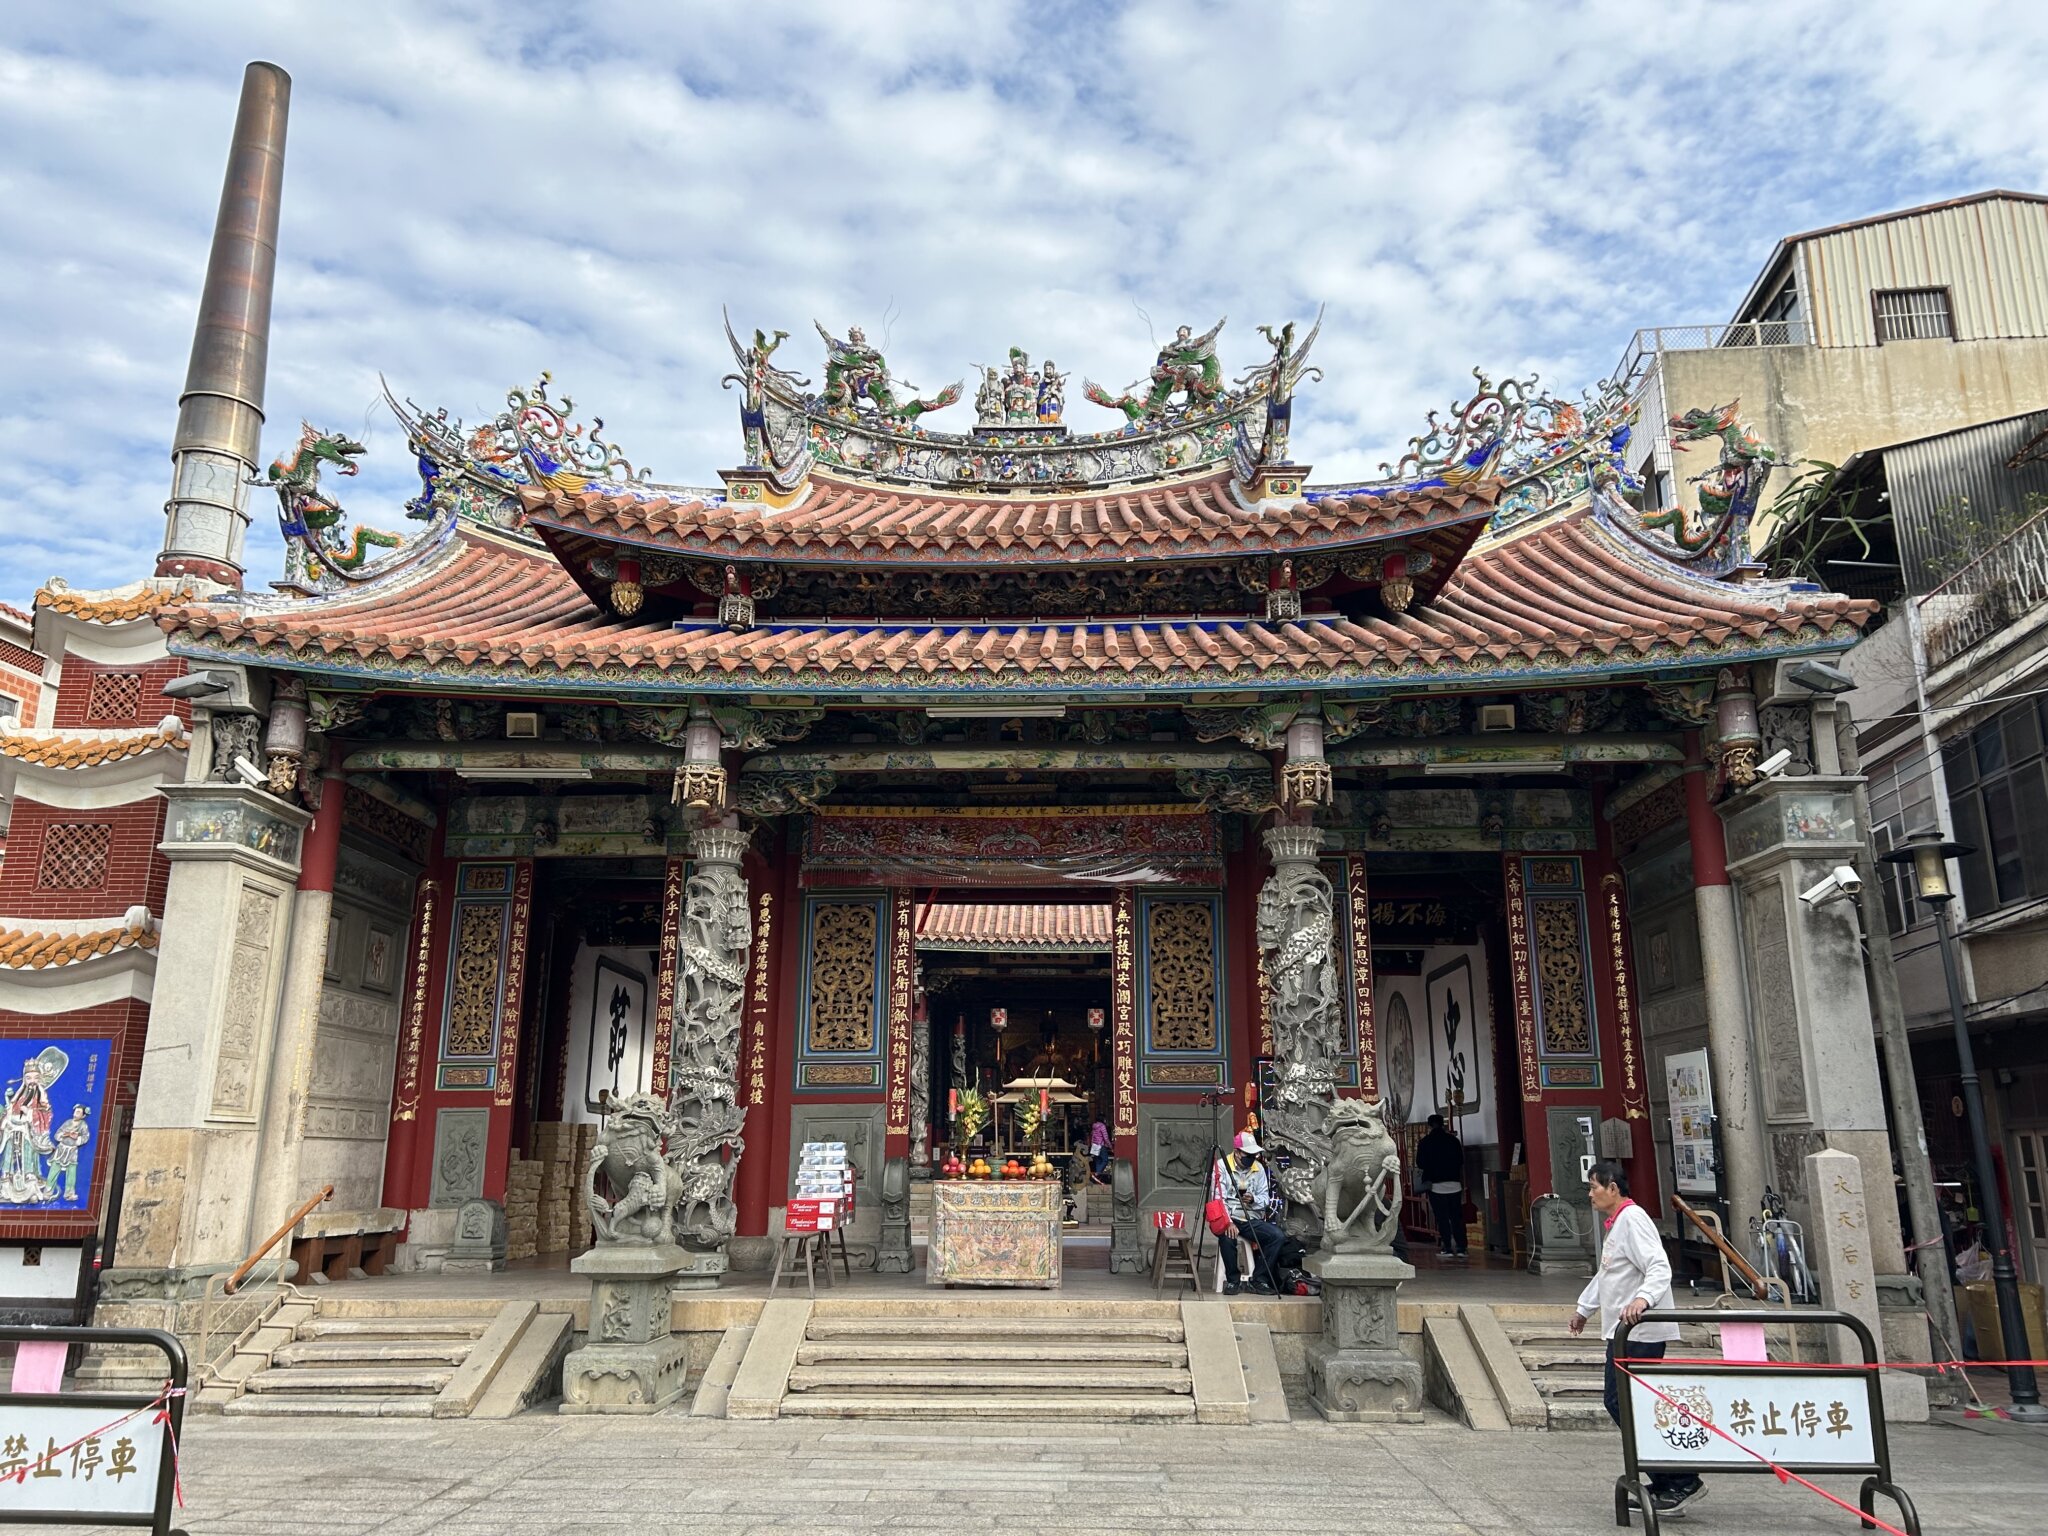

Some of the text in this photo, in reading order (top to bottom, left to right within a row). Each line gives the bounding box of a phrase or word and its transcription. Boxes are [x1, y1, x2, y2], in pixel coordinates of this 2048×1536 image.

[1833, 1175, 1865, 1299] 大天后宮
[1662, 1426, 1710, 1450] 大天后宮
[1729, 1398, 1853, 1439] 禁止停車
[0, 1433, 137, 1483] 禁止停車
